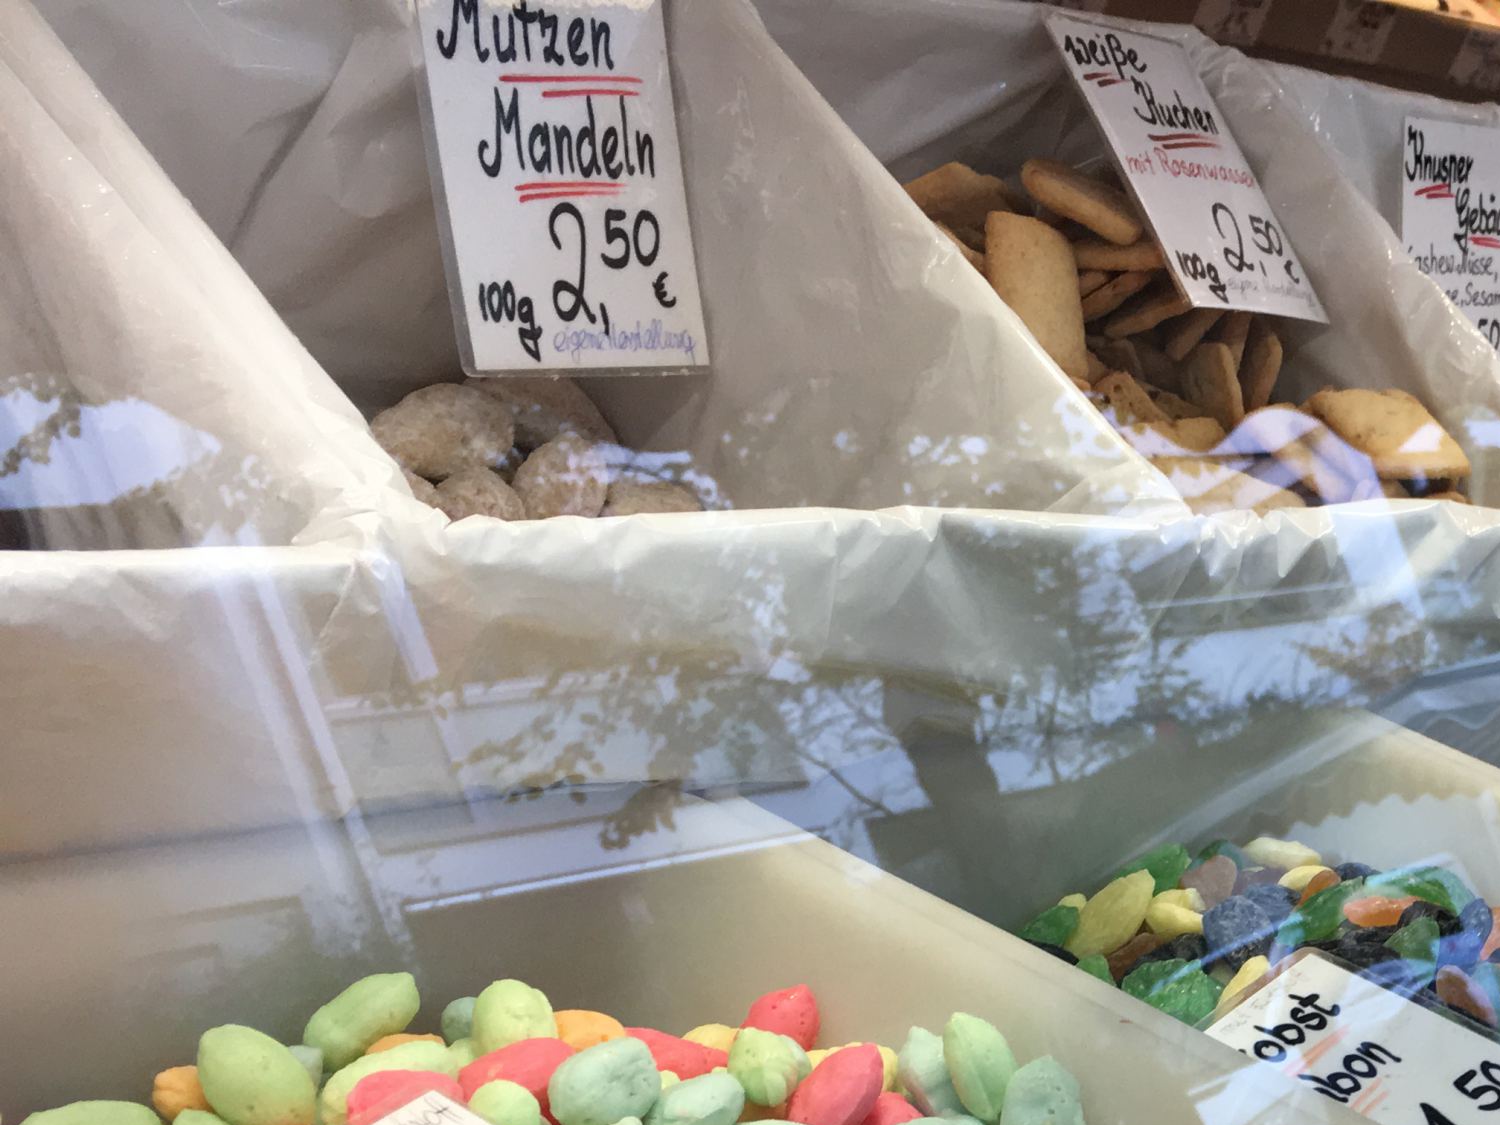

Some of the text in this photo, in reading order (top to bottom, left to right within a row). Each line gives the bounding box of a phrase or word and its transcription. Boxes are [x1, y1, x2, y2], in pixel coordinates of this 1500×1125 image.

[437, 0, 614, 70] Mutzen
[1064, 33, 1147, 80] weiße
[478, 86, 656, 178] Mandeln
[1130, 75, 1219, 135] Kuchen
[1125, 151, 1156, 175] mit
[1405, 124, 1473, 195] Knusper
[1175, 250, 1230, 304] 100g
[478, 280, 543, 362] 100g
[652, 271, 677, 308] €
[1240, 993, 1341, 1063] obst
